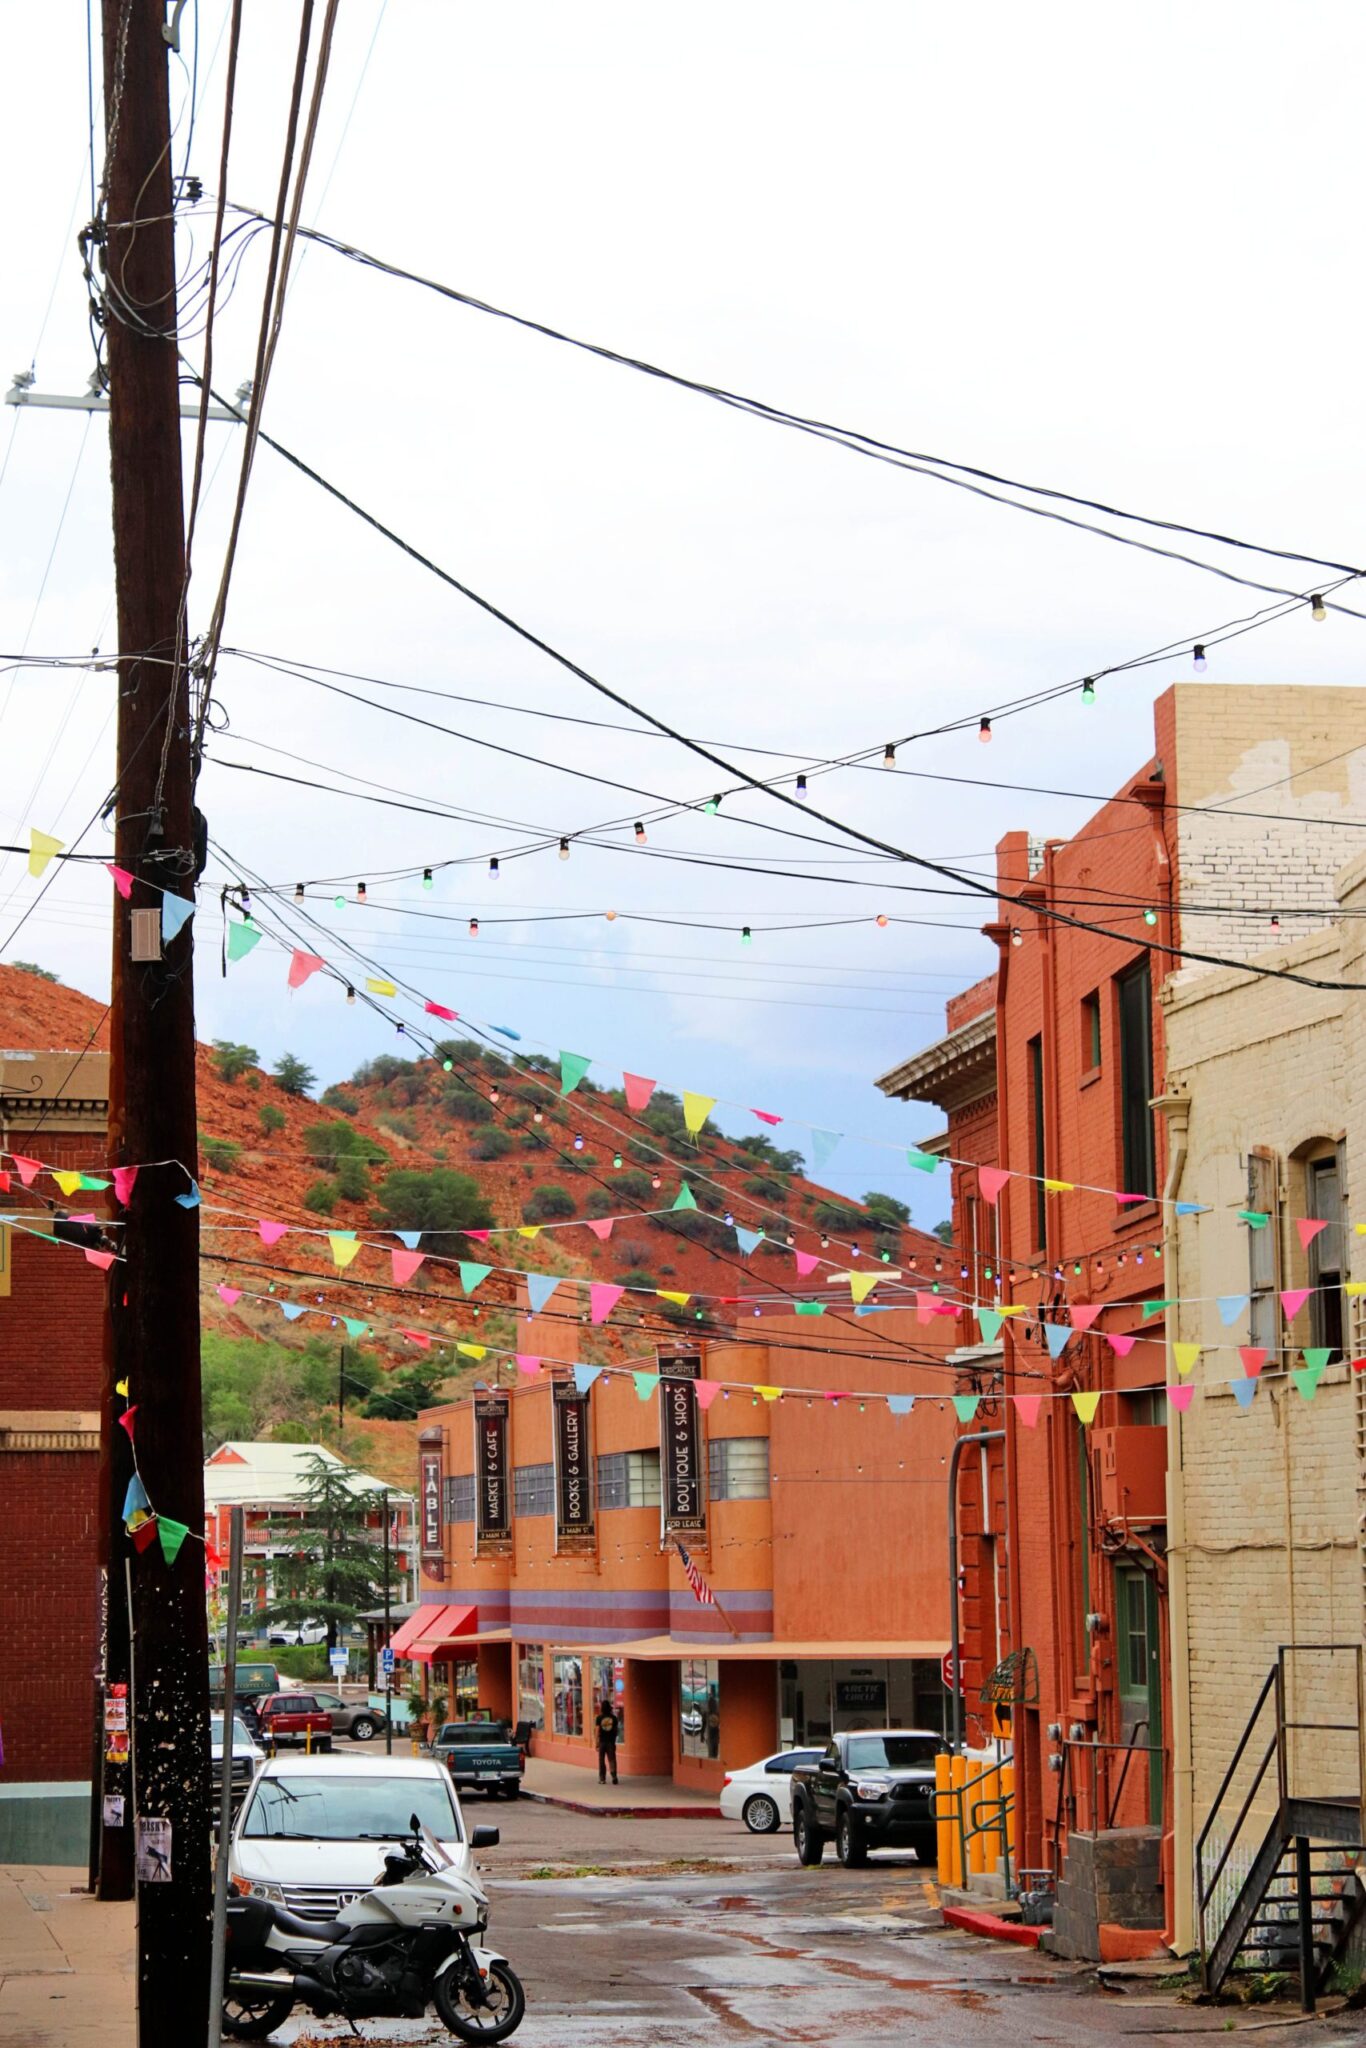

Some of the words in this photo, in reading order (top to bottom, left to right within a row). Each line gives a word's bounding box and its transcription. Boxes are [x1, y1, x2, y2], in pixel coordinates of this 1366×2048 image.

[674, 1387, 687, 1425] SHOPS
[566, 1410, 579, 1462] GALLERY
[676, 1432, 688, 1441] &
[486, 1430, 498, 1459] CAFE
[487, 1463, 498, 1471] &
[568, 1467, 579, 1475] &
[676, 1446, 690, 1512] BOUTIQUE
[488, 1475, 499, 1519] MARKET
[569, 1479, 580, 1519] BOOKS
[425, 1464, 438, 1543] TABLE
[666, 1520, 681, 1528] FOR
[682, 1519, 702, 1528] LEASE
[385, 1650, 392, 1660] P
[842, 1684, 880, 1693] ARCTIC
[844, 1693, 877, 1701] CIRCLE
[472, 1758, 502, 1766] TOYOTA
